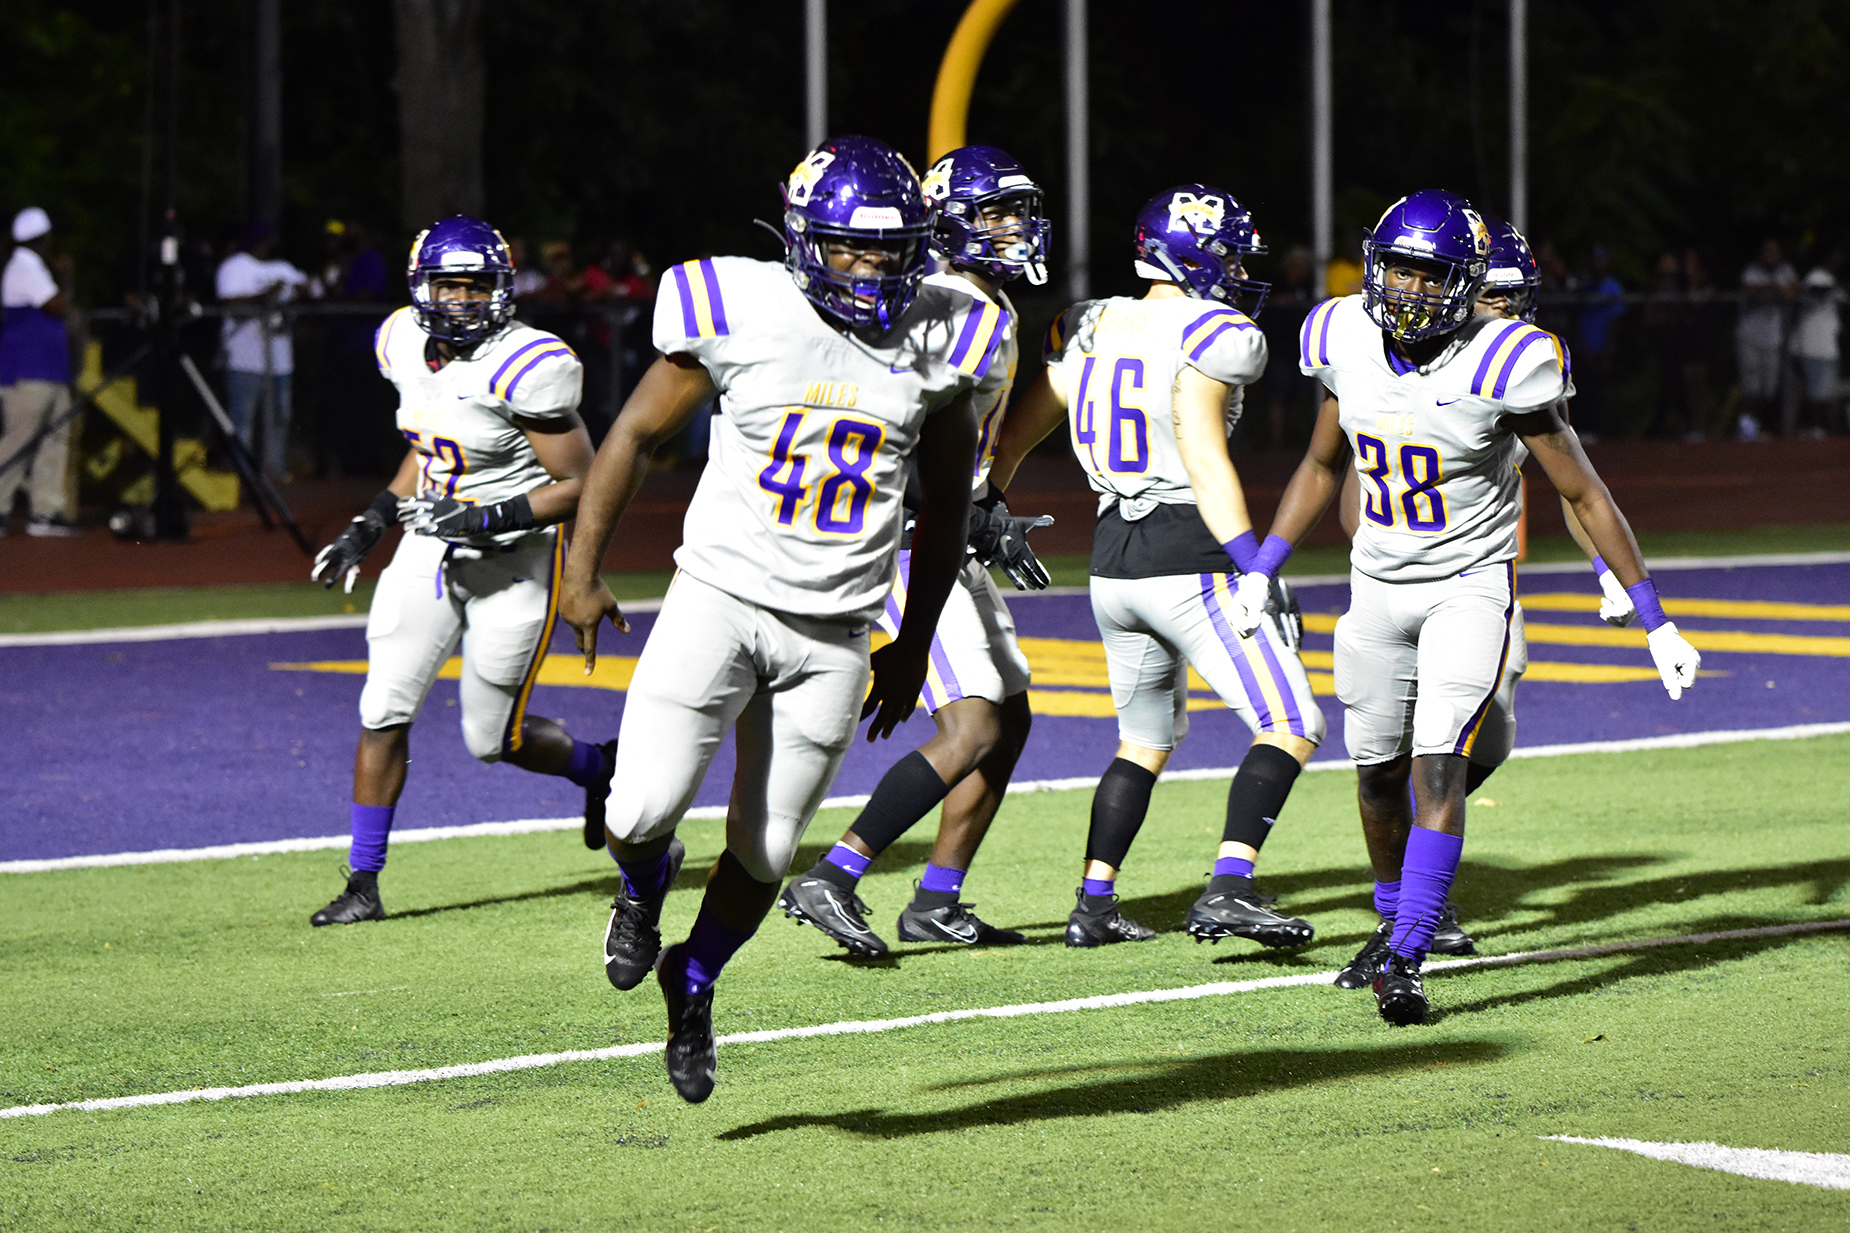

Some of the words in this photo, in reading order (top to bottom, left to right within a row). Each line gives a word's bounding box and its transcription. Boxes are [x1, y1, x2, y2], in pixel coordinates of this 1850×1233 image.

[804, 380, 859, 407] MILES
[1074, 352, 1151, 479] 46
[1375, 413, 1415, 436] MILES
[755, 405, 888, 541] 48
[1354, 430, 1451, 535] 38
